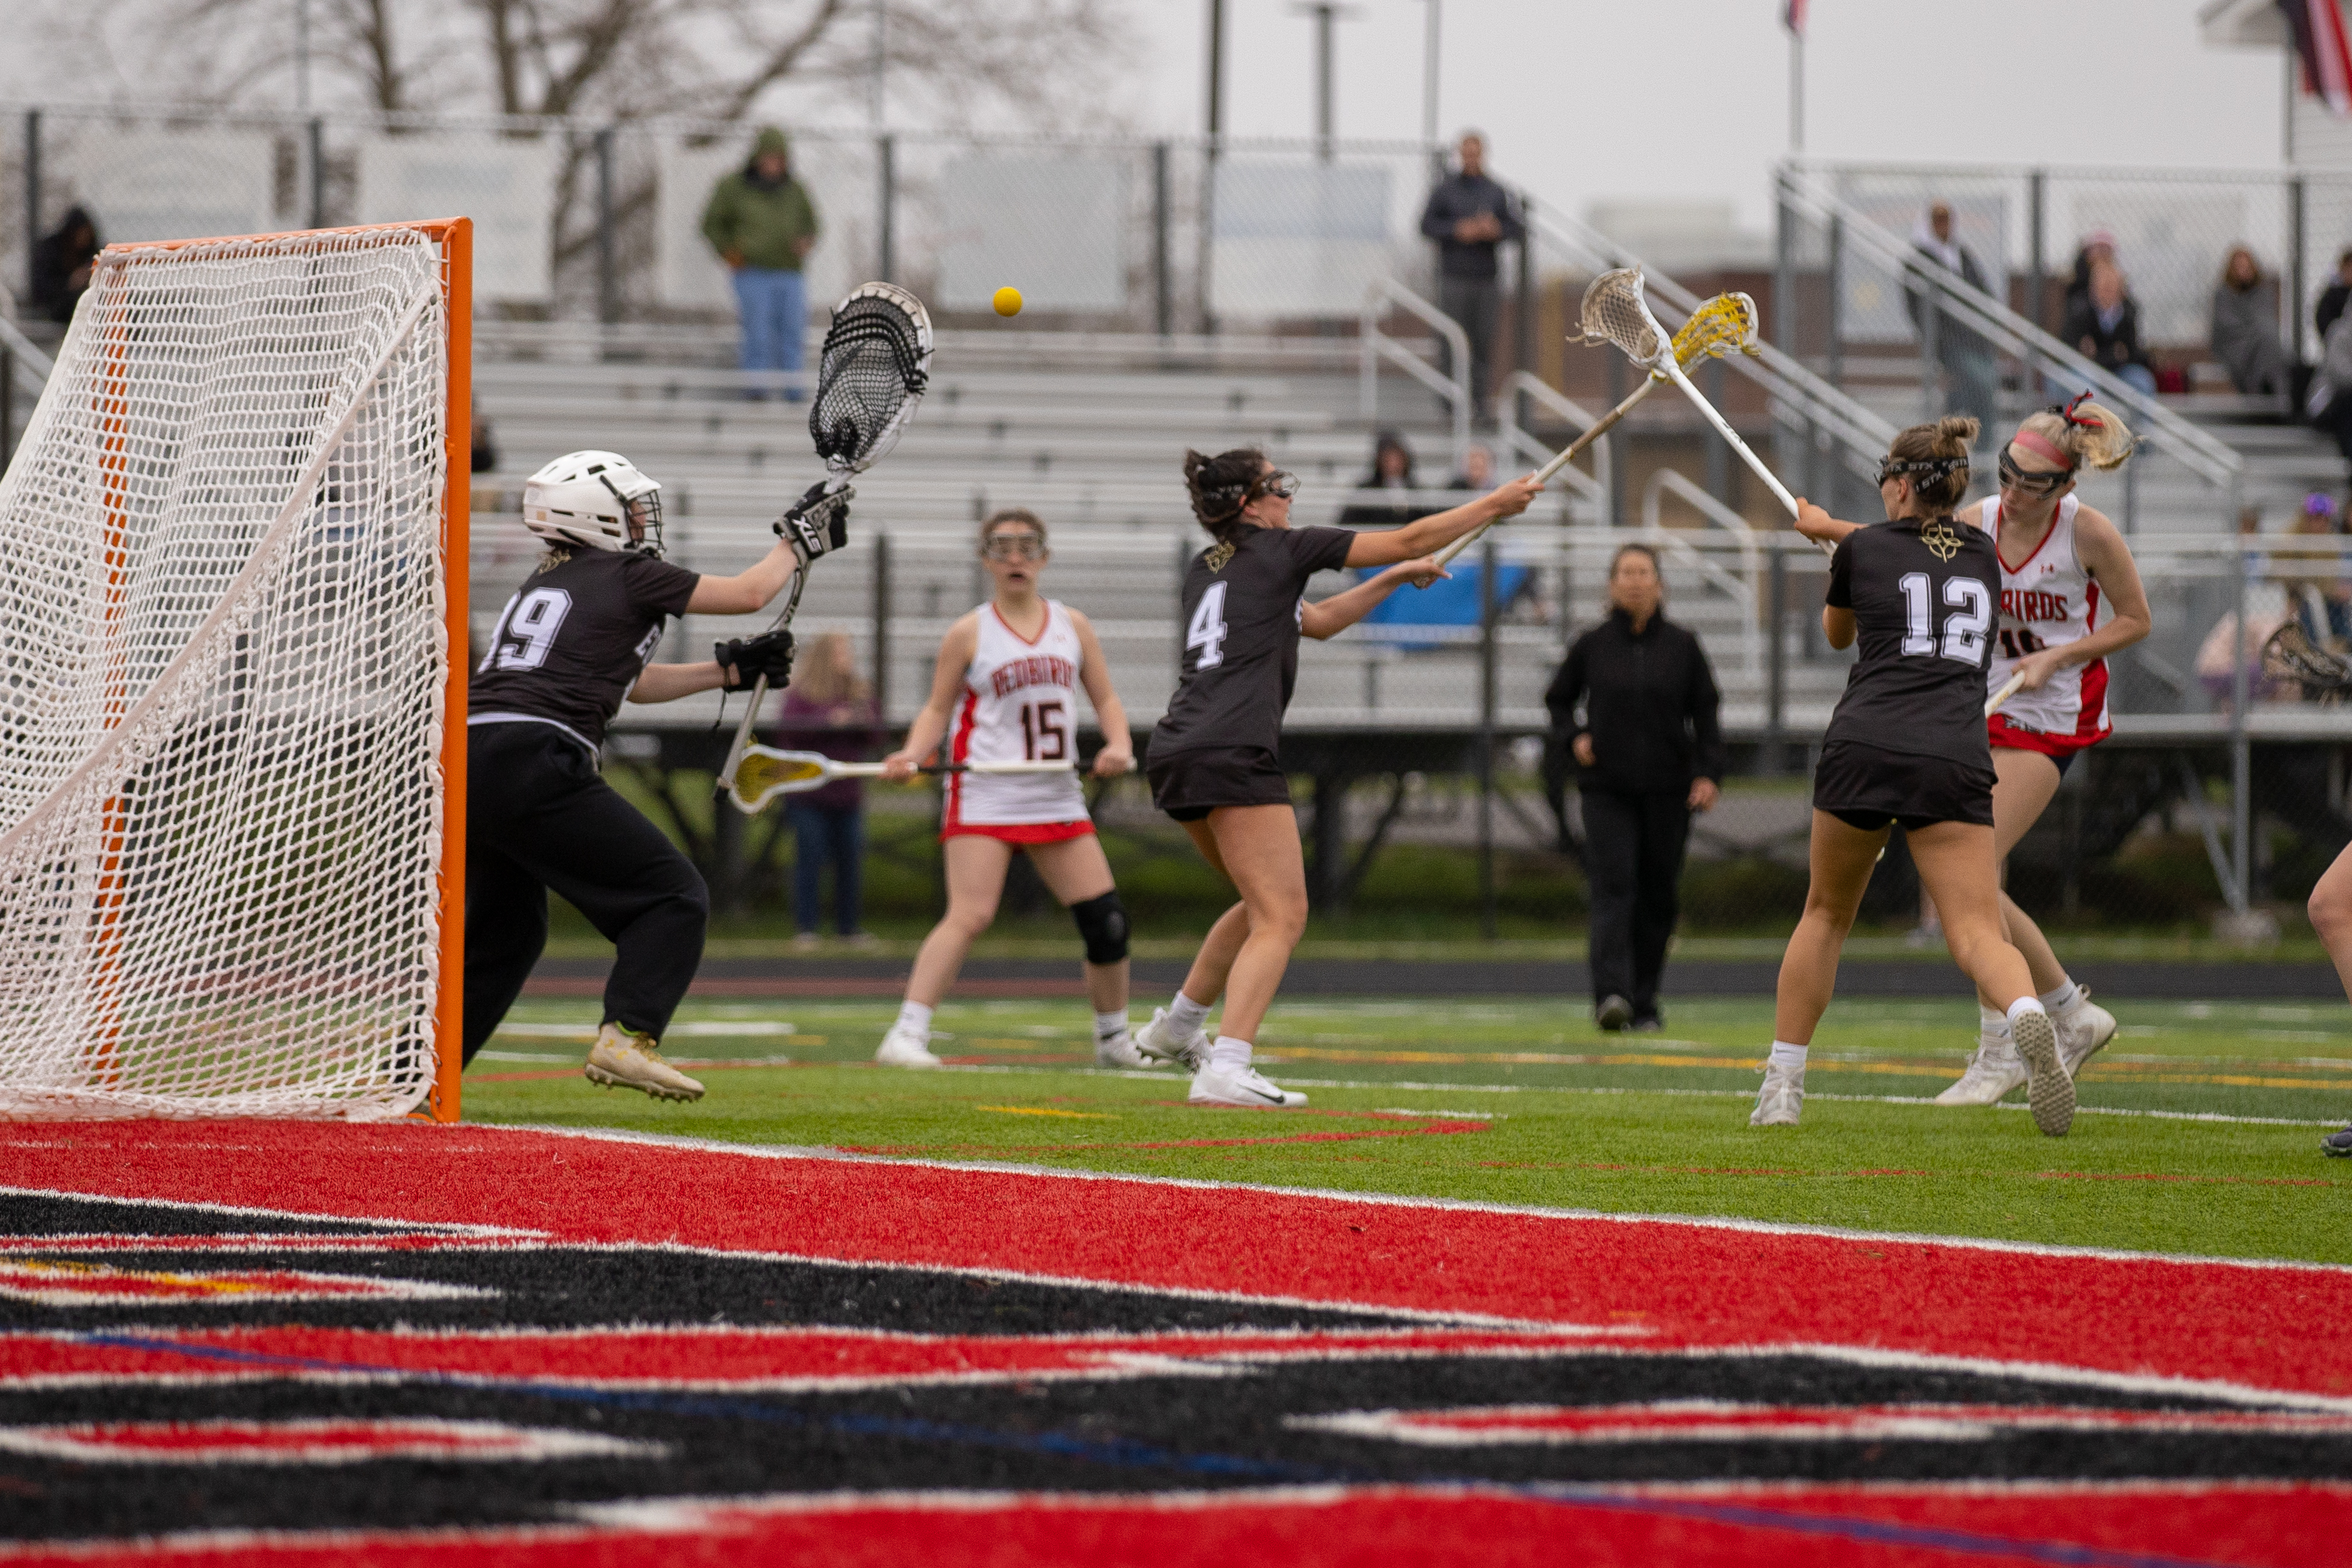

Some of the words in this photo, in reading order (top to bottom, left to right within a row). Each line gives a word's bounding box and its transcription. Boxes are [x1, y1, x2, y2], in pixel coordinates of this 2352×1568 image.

[1908, 461, 1934, 471] STX
[1922, 470, 1943, 489] STX
[791, 515, 823, 553] STX
[1186, 580, 1228, 672] 4
[1899, 572, 1992, 668] 12
[1022, 703, 1065, 760] 15
